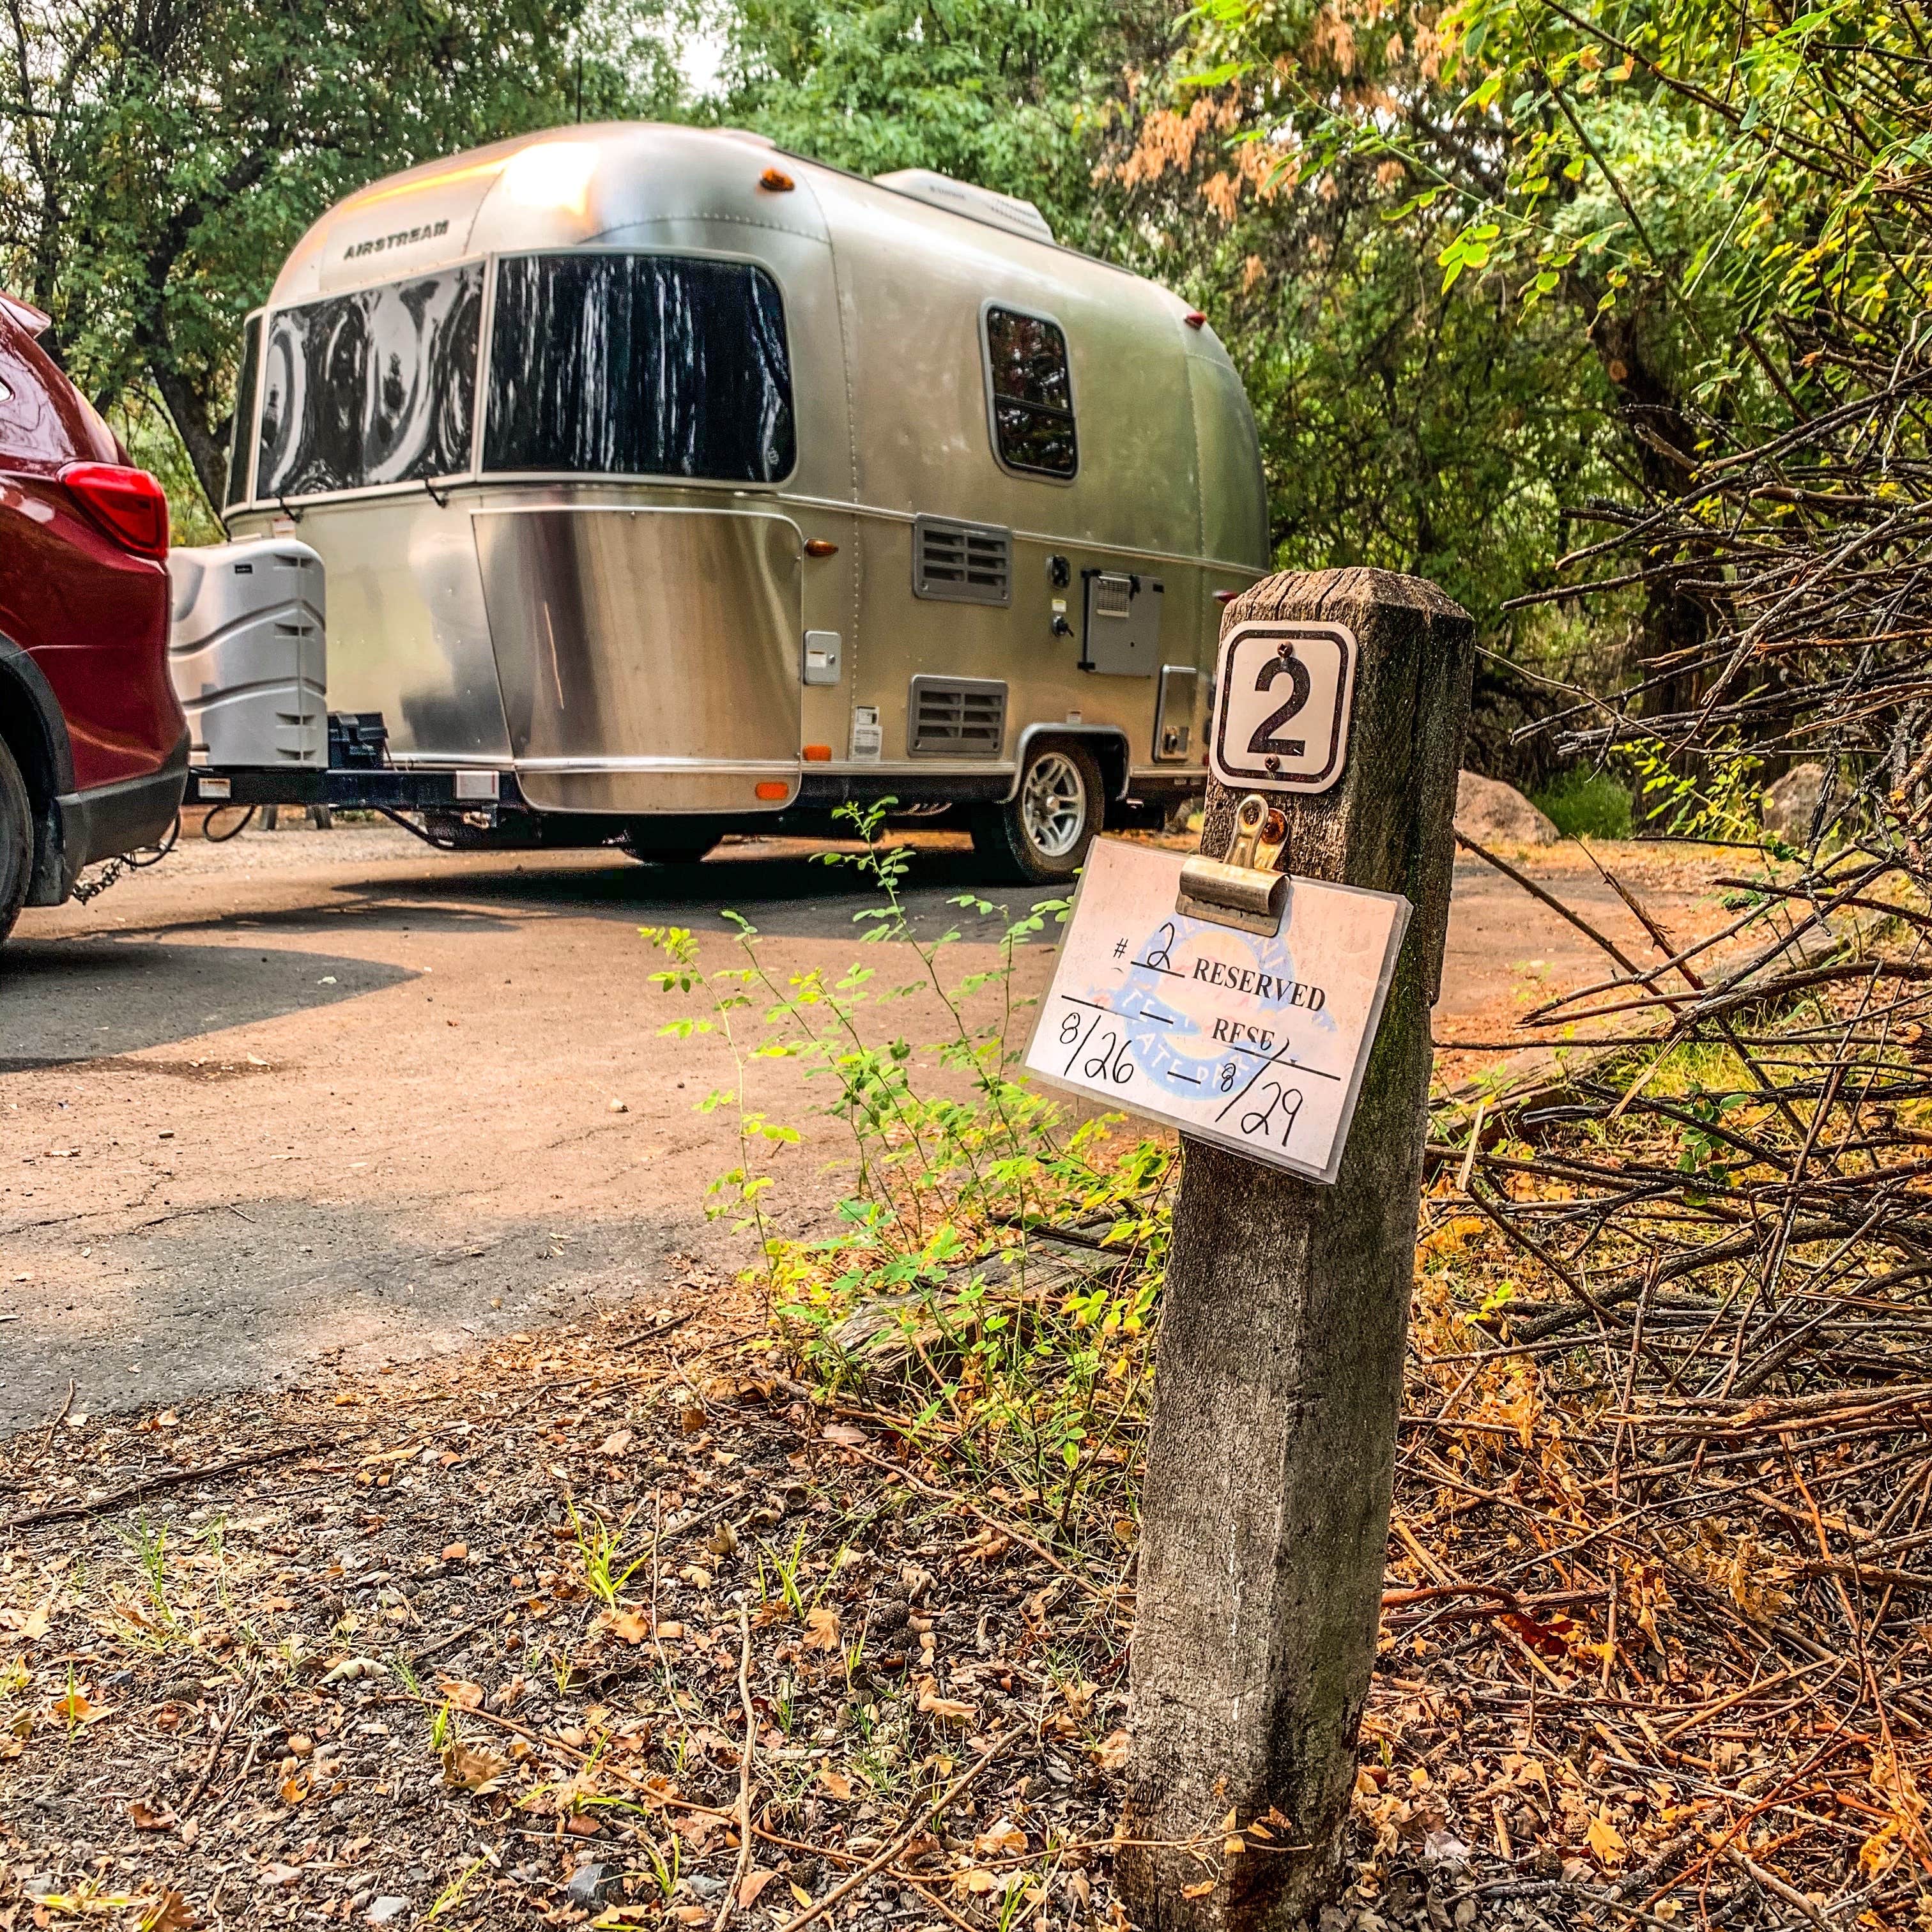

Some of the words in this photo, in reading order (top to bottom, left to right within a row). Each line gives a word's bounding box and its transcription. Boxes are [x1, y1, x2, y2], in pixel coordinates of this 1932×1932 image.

[343, 219, 449, 260] AIRSTREAM
[1247, 656, 1310, 756] 2
[1113, 937, 1129, 959] #
[1146, 922, 1175, 969] 2
[1192, 957, 1326, 1011] RESERVED
[1059, 1012, 1134, 1084] 8/26
[1208, 1038, 1303, 1147] 8/29
